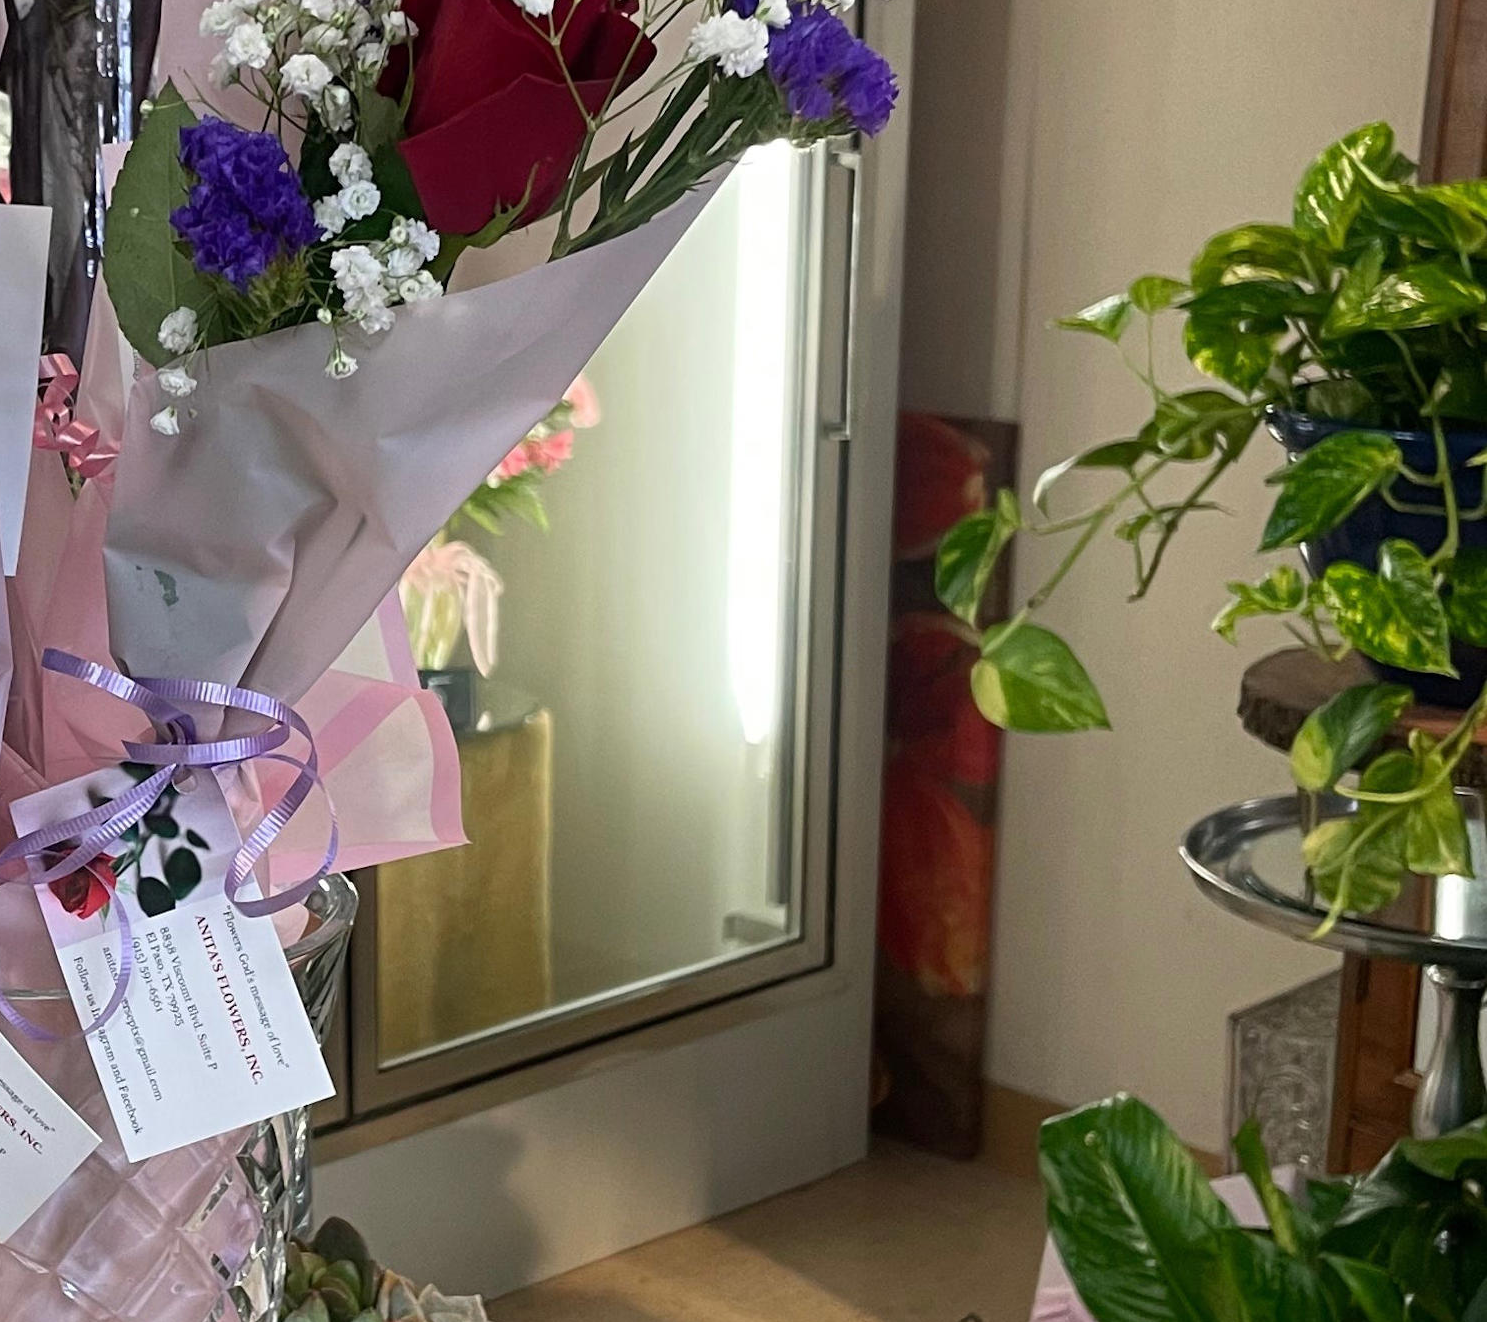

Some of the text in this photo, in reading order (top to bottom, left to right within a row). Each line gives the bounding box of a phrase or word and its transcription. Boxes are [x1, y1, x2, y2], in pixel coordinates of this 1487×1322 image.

[139, 966, 163, 1012] 591-6561
[145, 932, 184, 1026] El Paso, TX 79925
[160, 926, 177, 955] 8838
[171, 955, 192, 1002] Viscount
[197, 1033, 212, 1060] Suite
[207, 1062, 218, 1070] P
[195, 916, 263, 1085] ANITA'S FLOWERS, INC.
[223, 905, 290, 1068] "Flowers God's message of love"
[73, 956, 143, 1135] Follow us Intagram and Facebook
[19, 1129, 42, 1154] INC.
[23, 1105, 35, 1115] of
